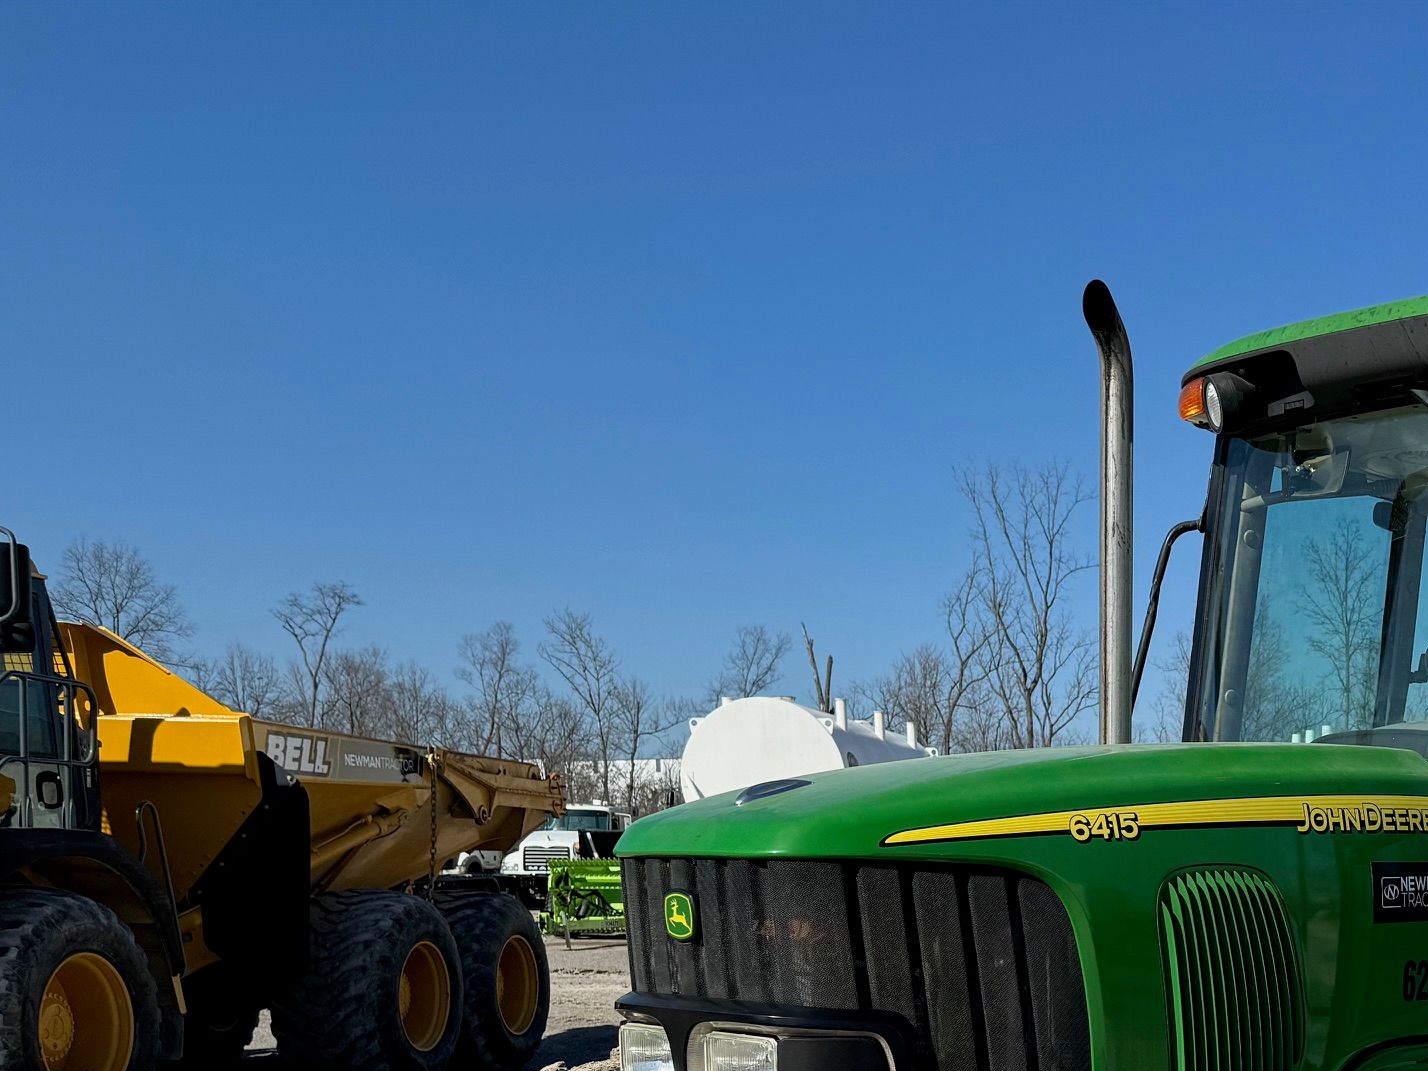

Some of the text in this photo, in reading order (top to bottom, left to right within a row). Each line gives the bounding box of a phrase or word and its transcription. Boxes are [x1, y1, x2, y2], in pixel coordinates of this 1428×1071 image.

[267, 734, 329, 775] BELL
[1069, 811, 1141, 843] 6415
[1297, 802, 1362, 834] JOHN
